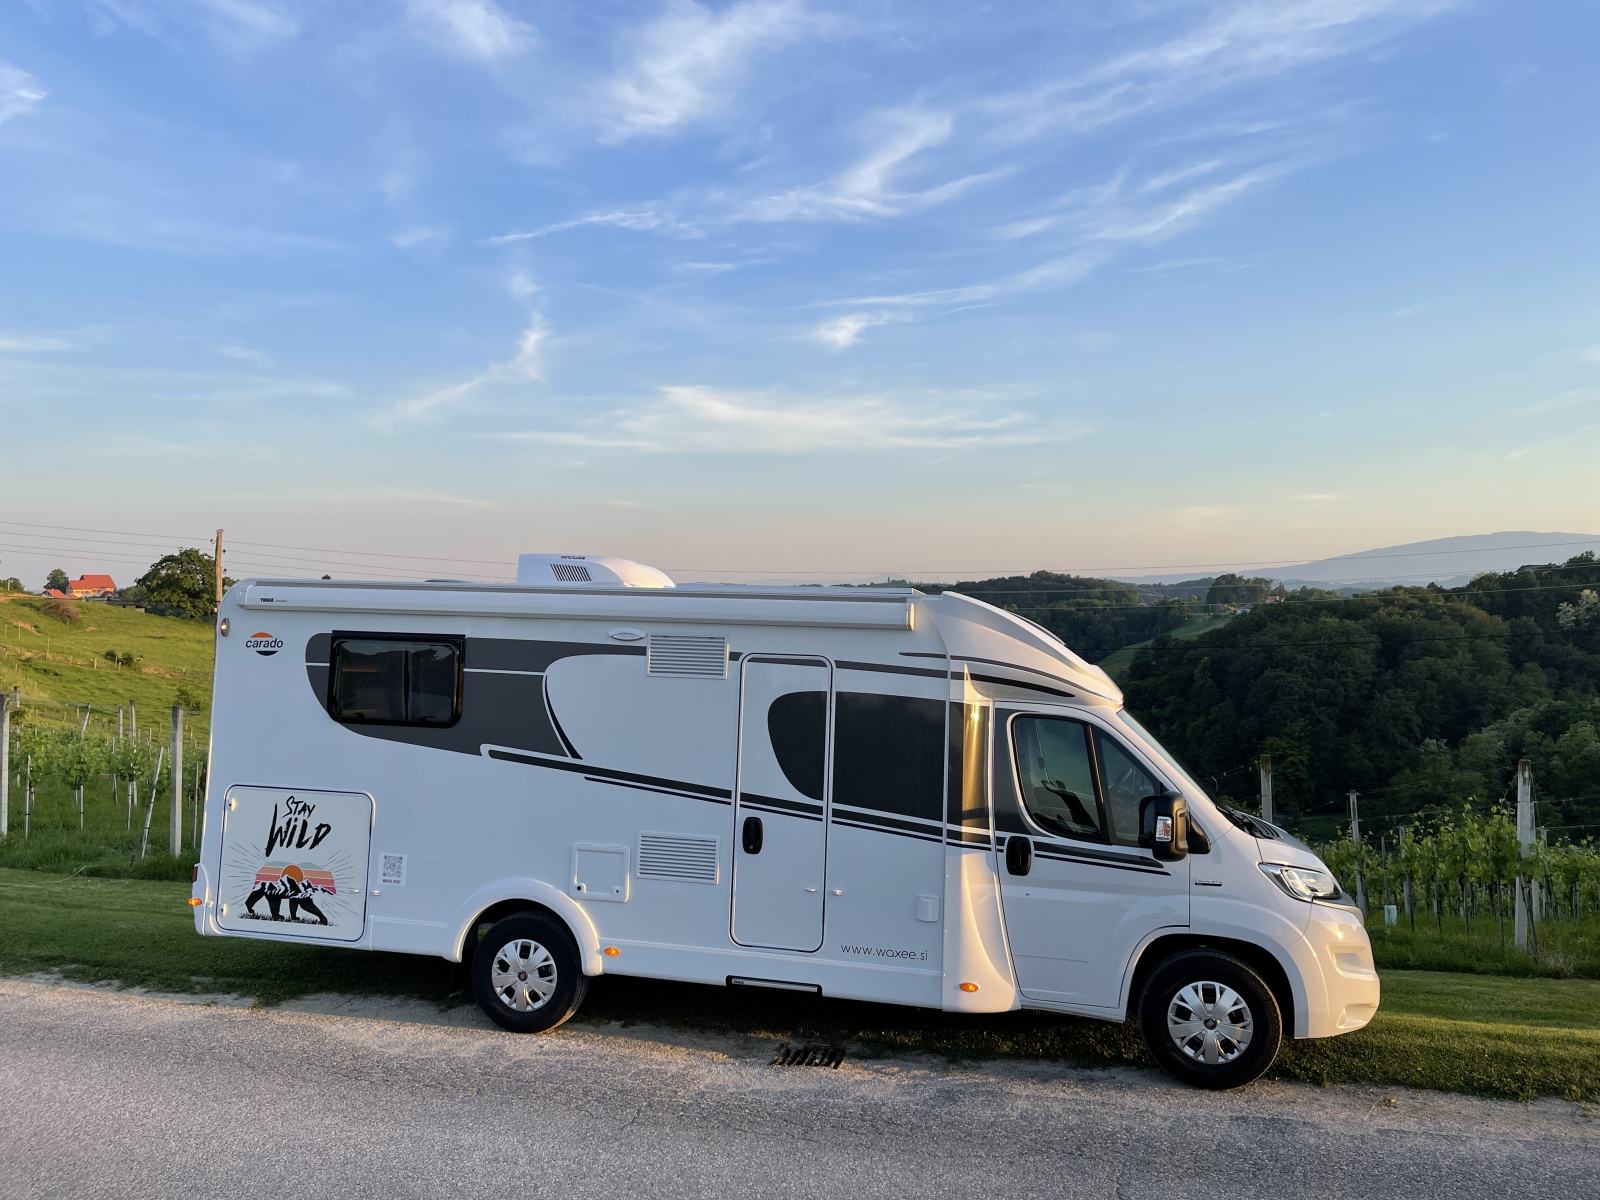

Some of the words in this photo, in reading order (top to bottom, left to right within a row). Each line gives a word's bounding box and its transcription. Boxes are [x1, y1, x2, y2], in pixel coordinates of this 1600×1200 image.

[245, 638, 284, 648] carado
[282, 795, 316, 818] STAY
[840, 944, 928, 961] www.waxee.si
